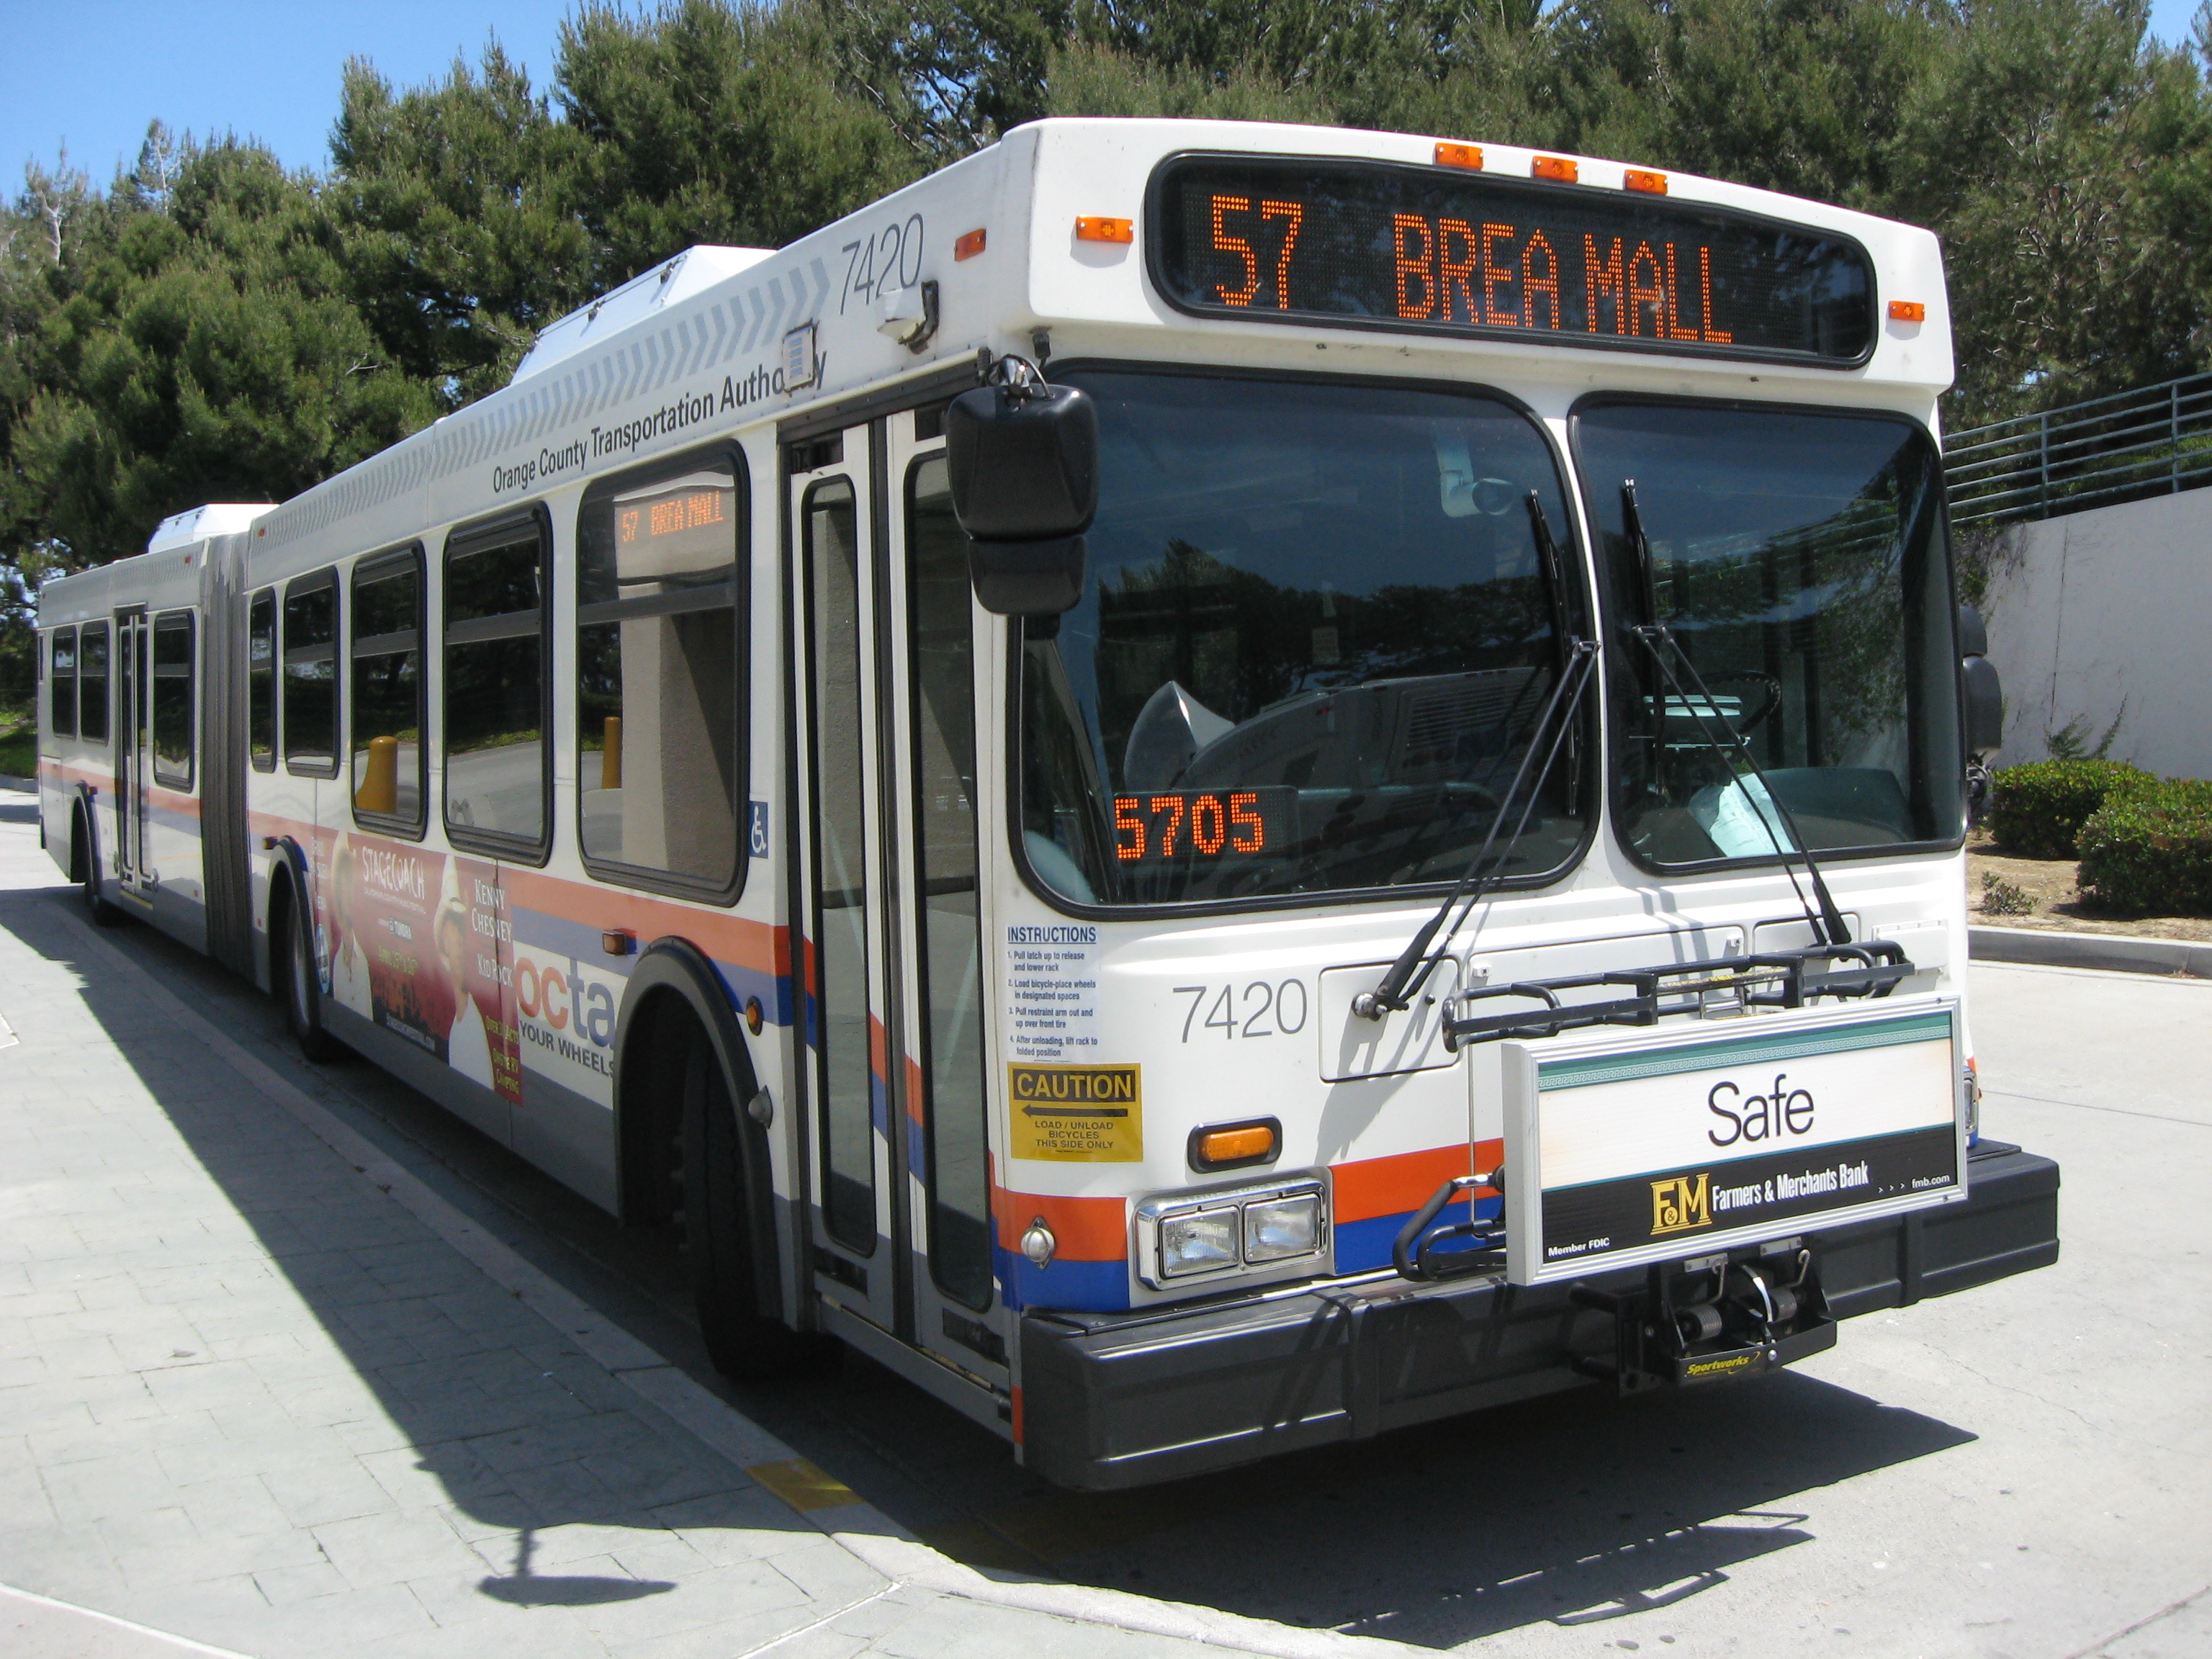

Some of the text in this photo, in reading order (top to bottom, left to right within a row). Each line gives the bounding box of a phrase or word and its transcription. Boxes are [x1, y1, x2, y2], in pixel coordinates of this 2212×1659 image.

[840, 213, 924, 315] 7420
[1210, 194, 1732, 343] 57 BREA MALL
[493, 350, 827, 493] Orange County Transportation Authoy
[622, 511, 639, 542] 57
[1114, 793, 1265, 859] 5705
[1007, 927, 1097, 942] INSTRUCTIONS
[1027, 951, 1042, 960] latch
[1044, 953, 1052, 962] up
[1061, 951, 1085, 960] release
[1014, 963, 1059, 971] and lower rack
[1015, 979, 1030, 988] Load
[1074, 979, 1096, 988] wheels
[516, 958, 616, 1050] octa
[1015, 991, 1020, 999] in
[1022, 991, 1056, 1002] designated
[1015, 1007, 1026, 1015] Pull
[1028, 1007, 1053, 1016] restraint
[1081, 1008, 1093, 1017] and
[1173, 978, 1308, 1043] 7420
[1039, 1020, 1054, 1028] front
[1056, 1020, 1066, 1028] tire
[519, 1020, 554, 1052] YOUR
[1076, 1037, 1089, 1046] rack
[1091, 1037, 1097, 1046] to
[1017, 1047, 1061, 1057] folded position
[1017, 1073, 1131, 1099] CAUTION
[1708, 1074, 1815, 1146] Safe
[1035, 1120, 1062, 1129] LOAD
[1071, 1121, 1113, 1130] UNLOAD
[1048, 1130, 1100, 1139] BICYCLES
[1035, 1139, 1057, 1148] THIS
[1712, 1160, 1870, 1212] Farmers & Merchants Bank
[1912, 1174, 1950, 1189] fmb.com
[1548, 1237, 1610, 1256] Member FDIC
[1687, 1356, 1750, 1375] Sportworks
